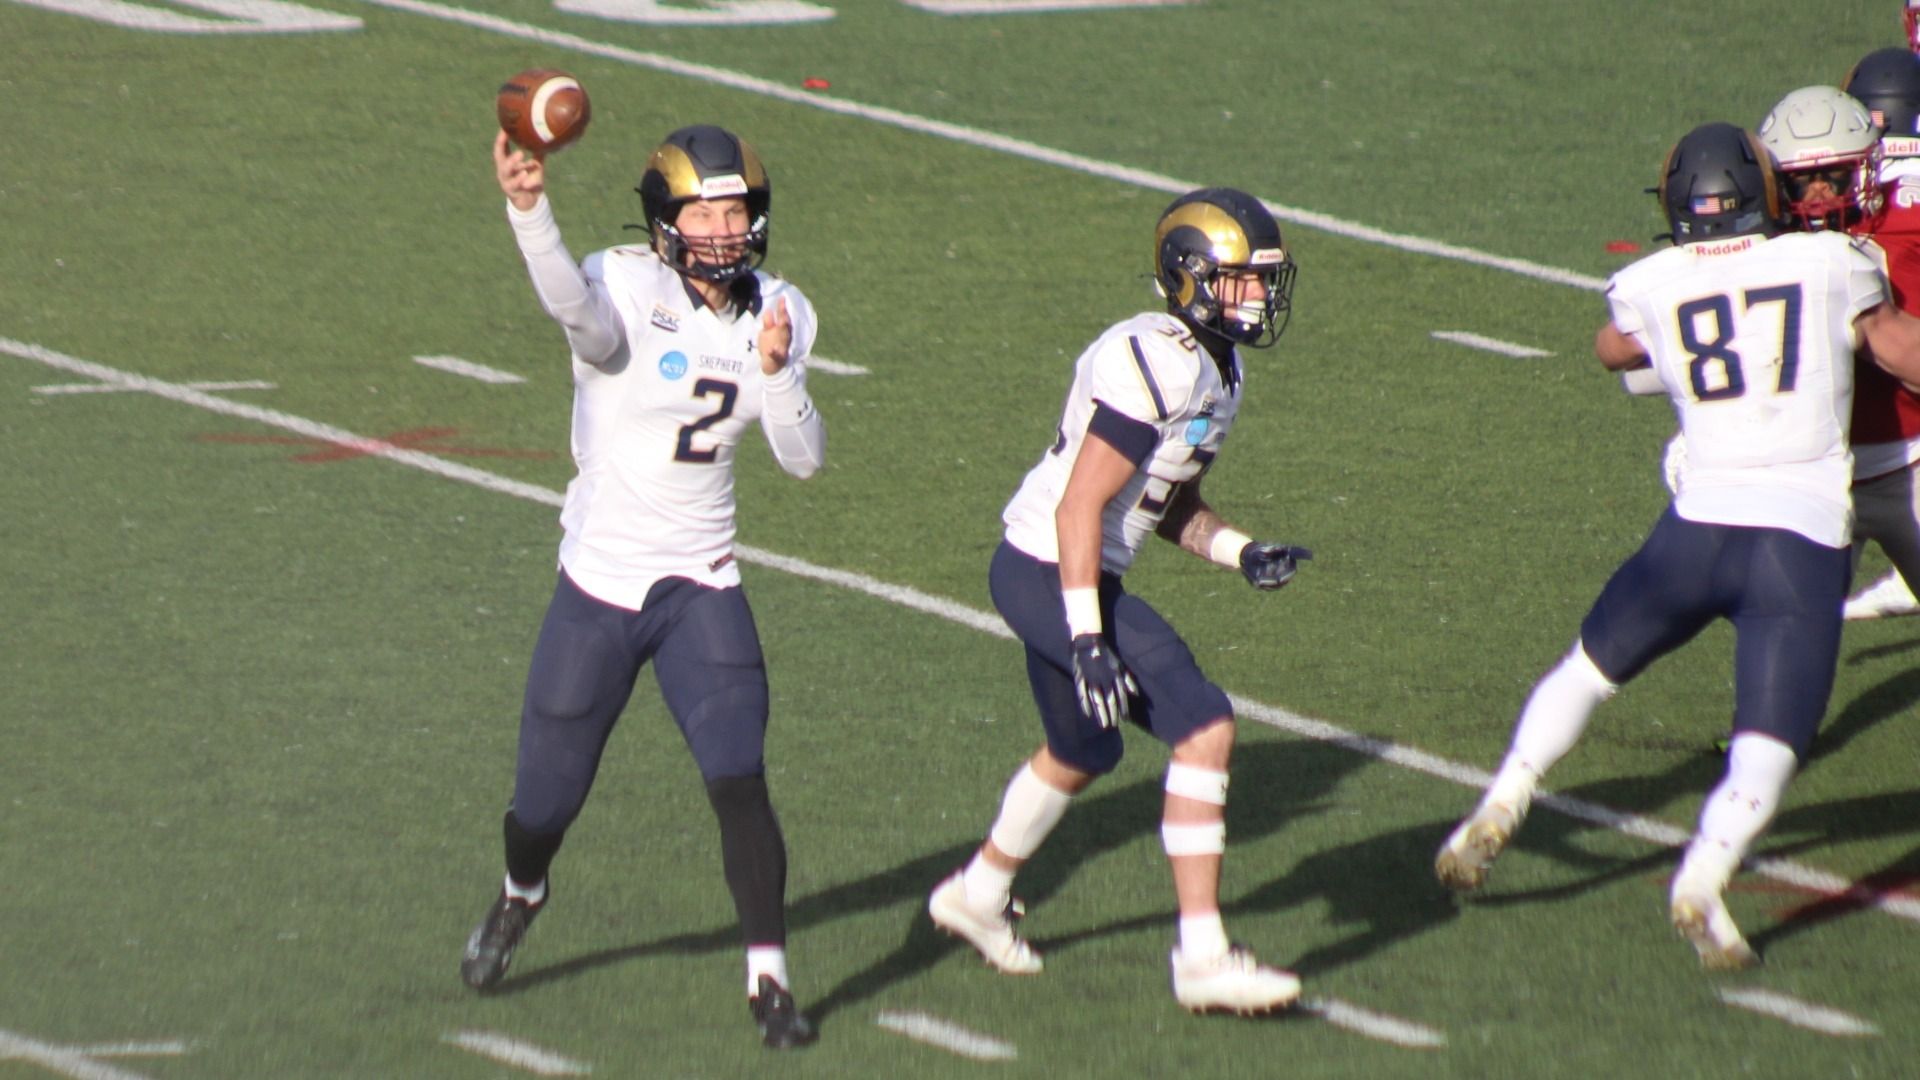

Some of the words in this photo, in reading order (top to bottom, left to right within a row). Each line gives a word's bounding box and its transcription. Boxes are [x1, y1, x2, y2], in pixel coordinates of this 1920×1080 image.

[1886, 140, 1919, 154] dell
[1695, 238, 1752, 256] Riddell
[1677, 283, 1803, 401] 87
[698, 354, 744, 374] SHEPHERD
[673, 377, 739, 463] 2
